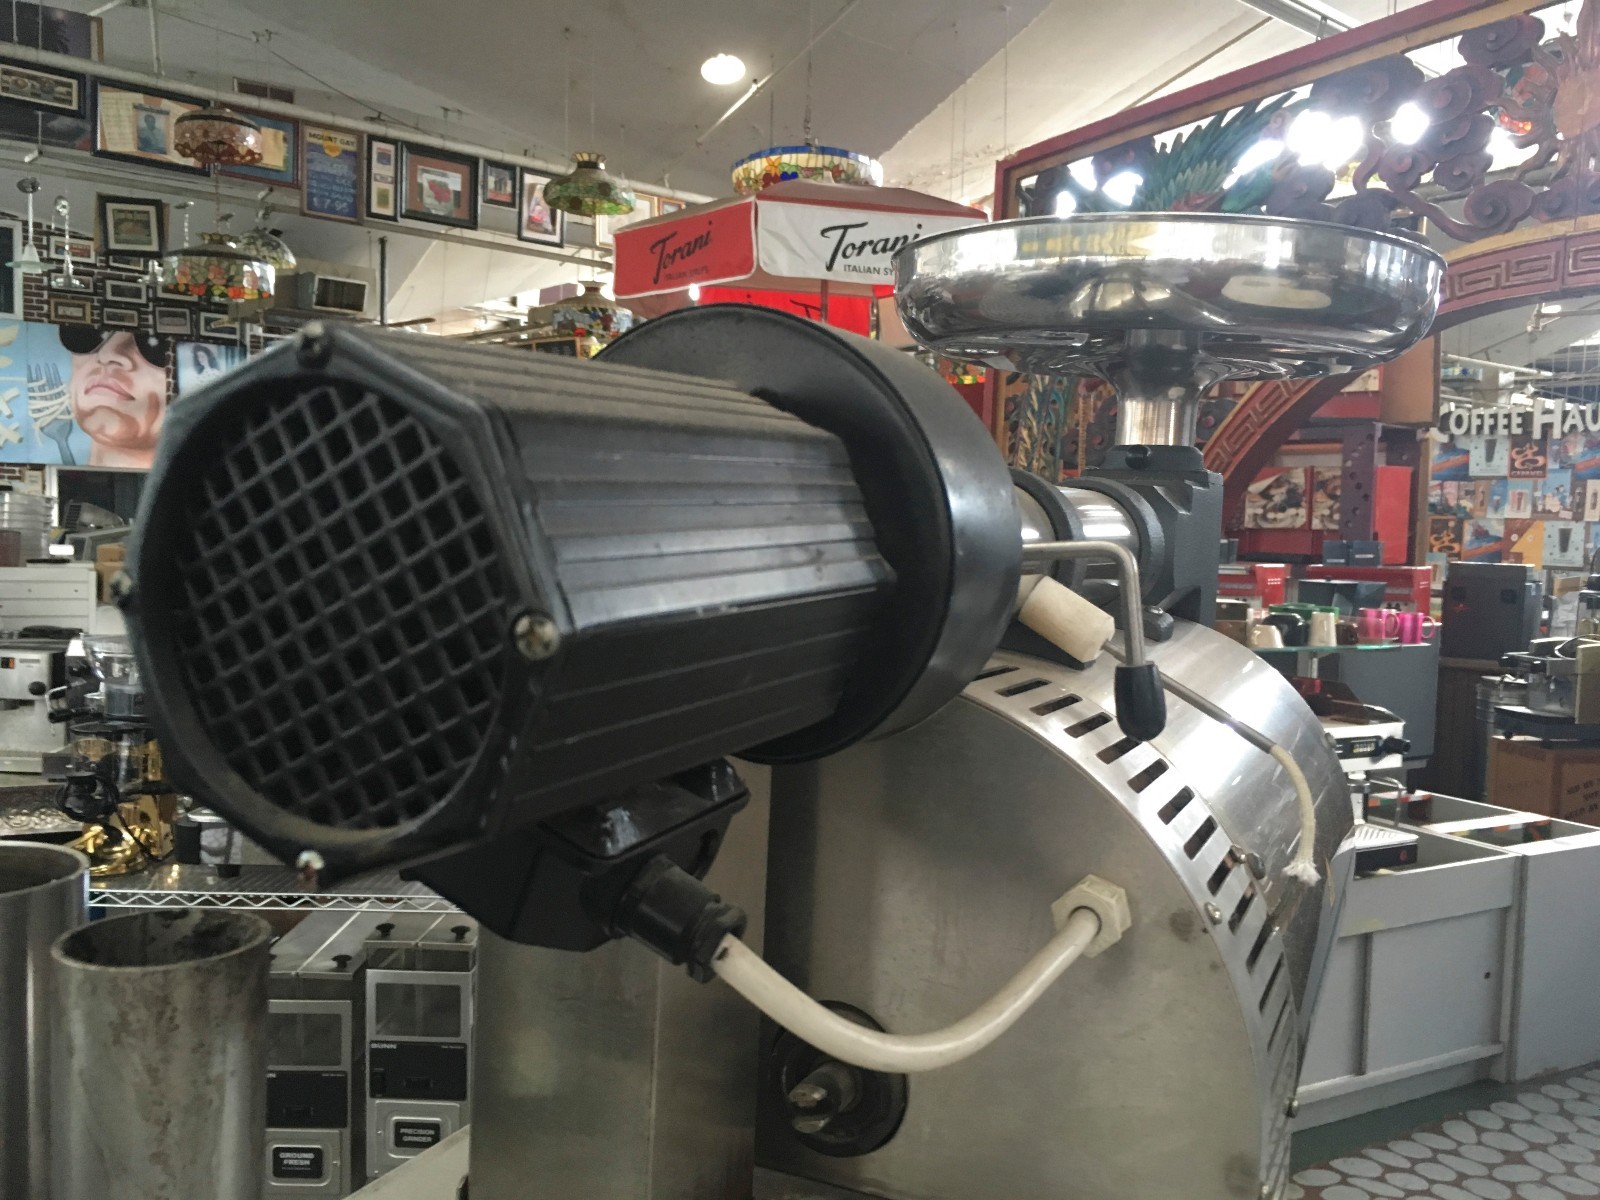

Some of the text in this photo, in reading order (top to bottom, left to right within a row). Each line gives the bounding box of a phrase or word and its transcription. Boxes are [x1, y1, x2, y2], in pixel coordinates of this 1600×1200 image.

[649, 220, 713, 285] Torani
[843, 264, 881, 275] ITALIAN
[400, 1128, 436, 1136] PRECISION
